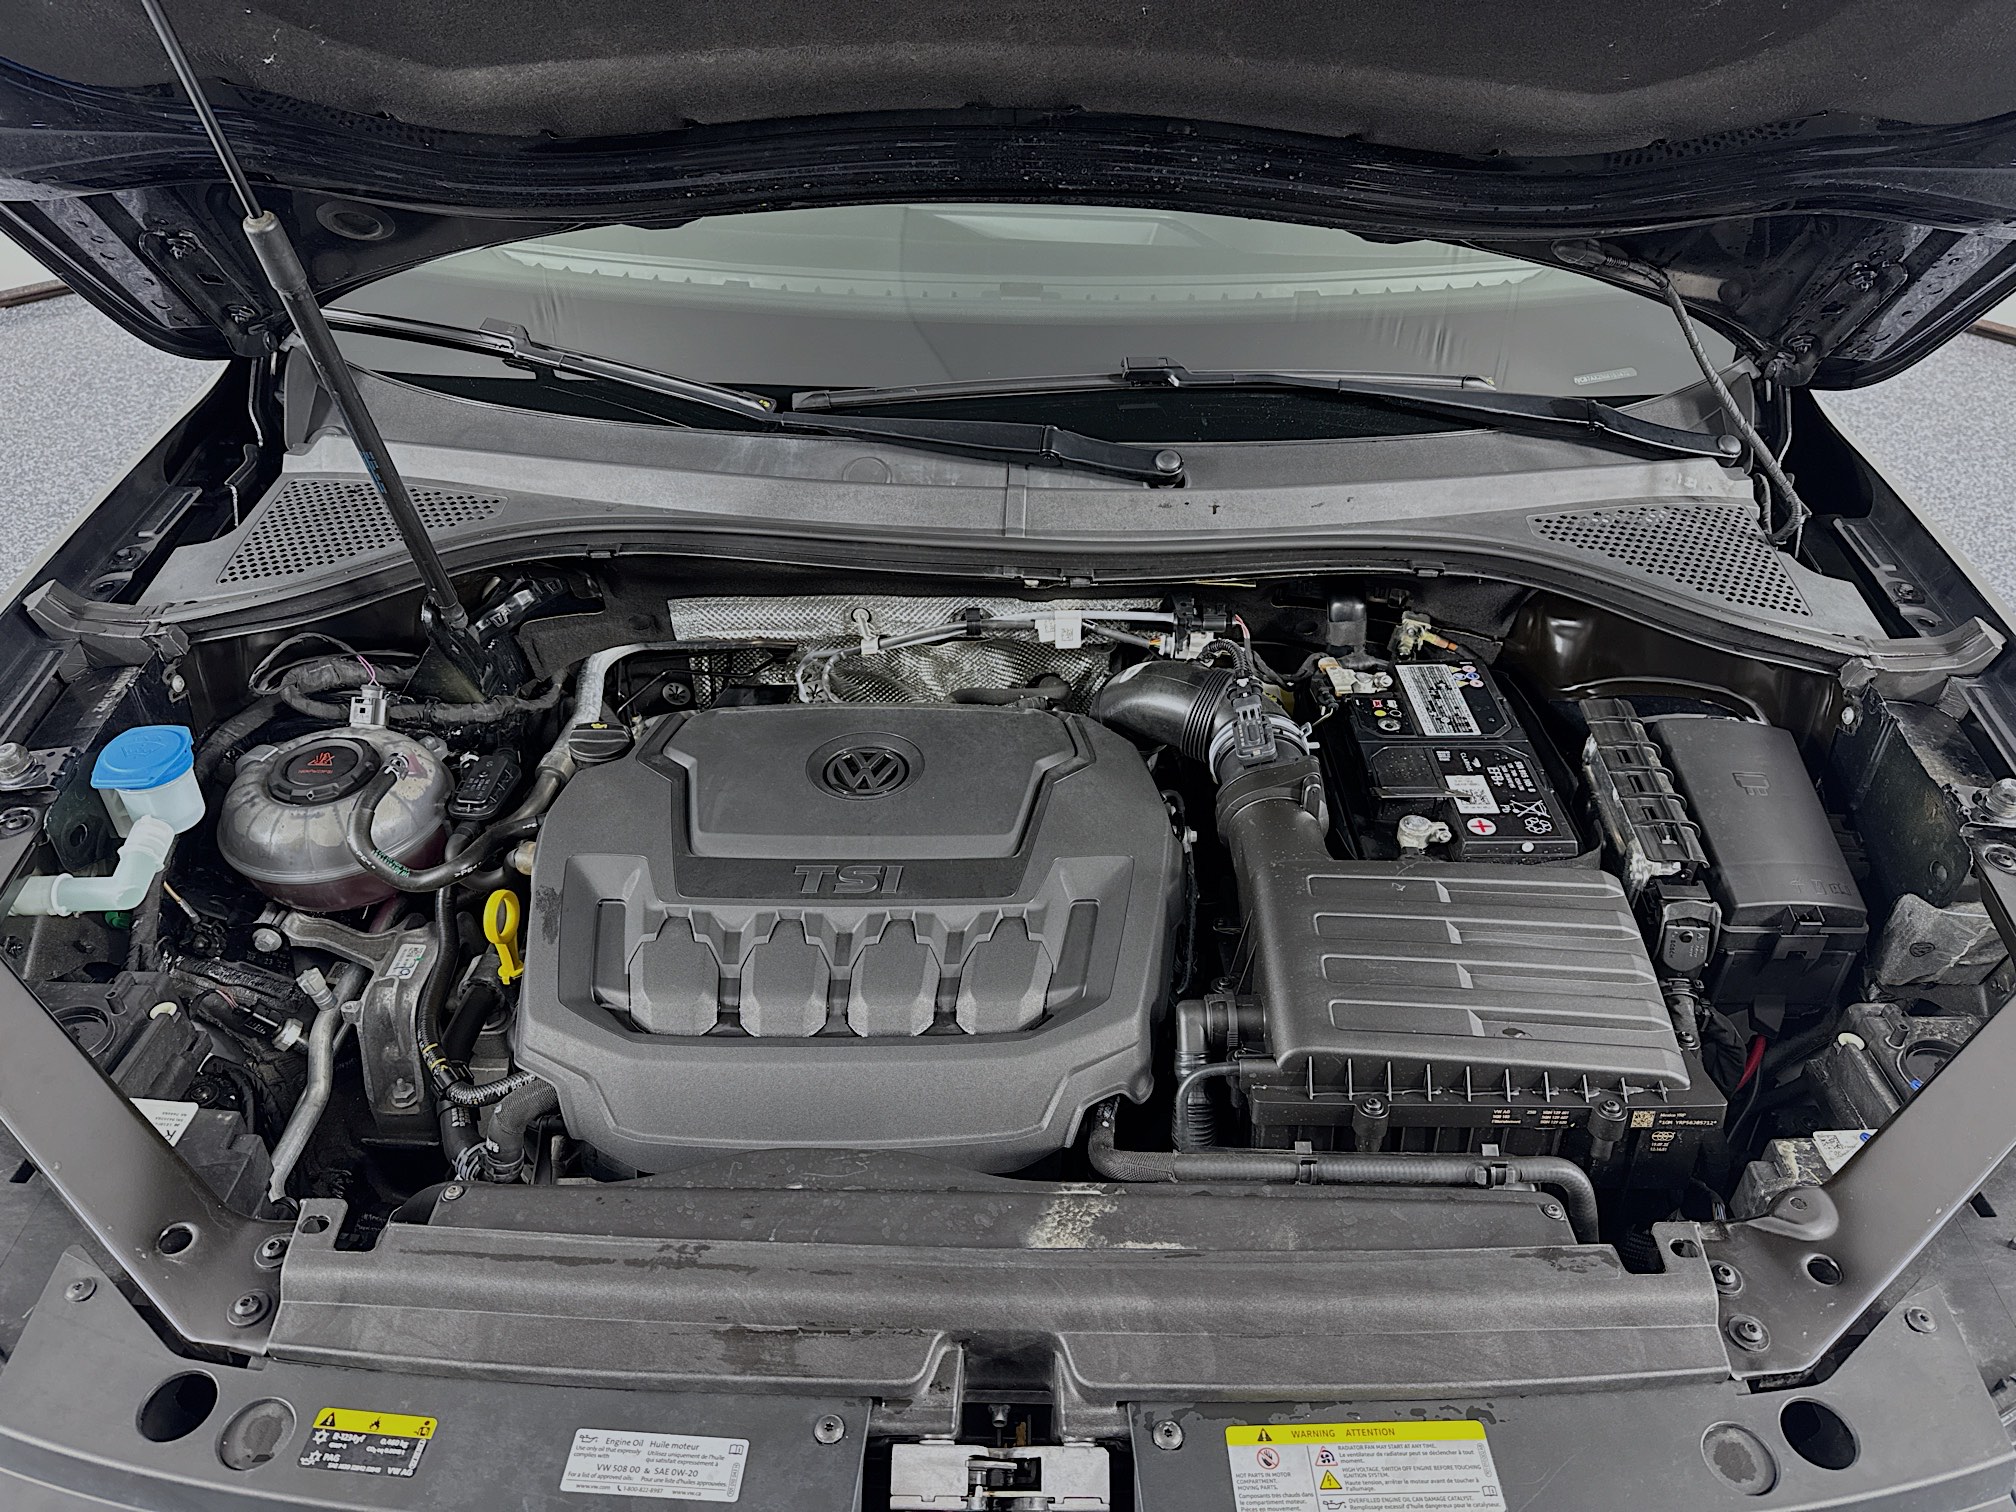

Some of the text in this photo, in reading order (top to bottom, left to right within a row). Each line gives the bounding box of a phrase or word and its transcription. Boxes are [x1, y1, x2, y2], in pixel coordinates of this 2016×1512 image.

[1486, 766, 1504, 787] EFB+
[1500, 804, 1511, 813] Pb
[794, 865, 904, 894] TSI
[1291, 1428, 1396, 1438] WARNING ATTENTION
[605, 1437, 700, 1451] Engine Oil Huile moteur
[617, 1448, 641, 1456] expressly
[387, 1466, 400, 1476] VW
[596, 1463, 612, 1471] VW
[612, 1464, 628, 1473] 508
[629, 1465, 641, 1474] 00
[653, 1467, 670, 1476] SAE
[671, 1468, 699, 1478] 0W-20
[597, 1473, 622, 1481] approved
[671, 1489, 702, 1497] www.vw.ca
[1424, 1502, 1452, 1510] dangereux
